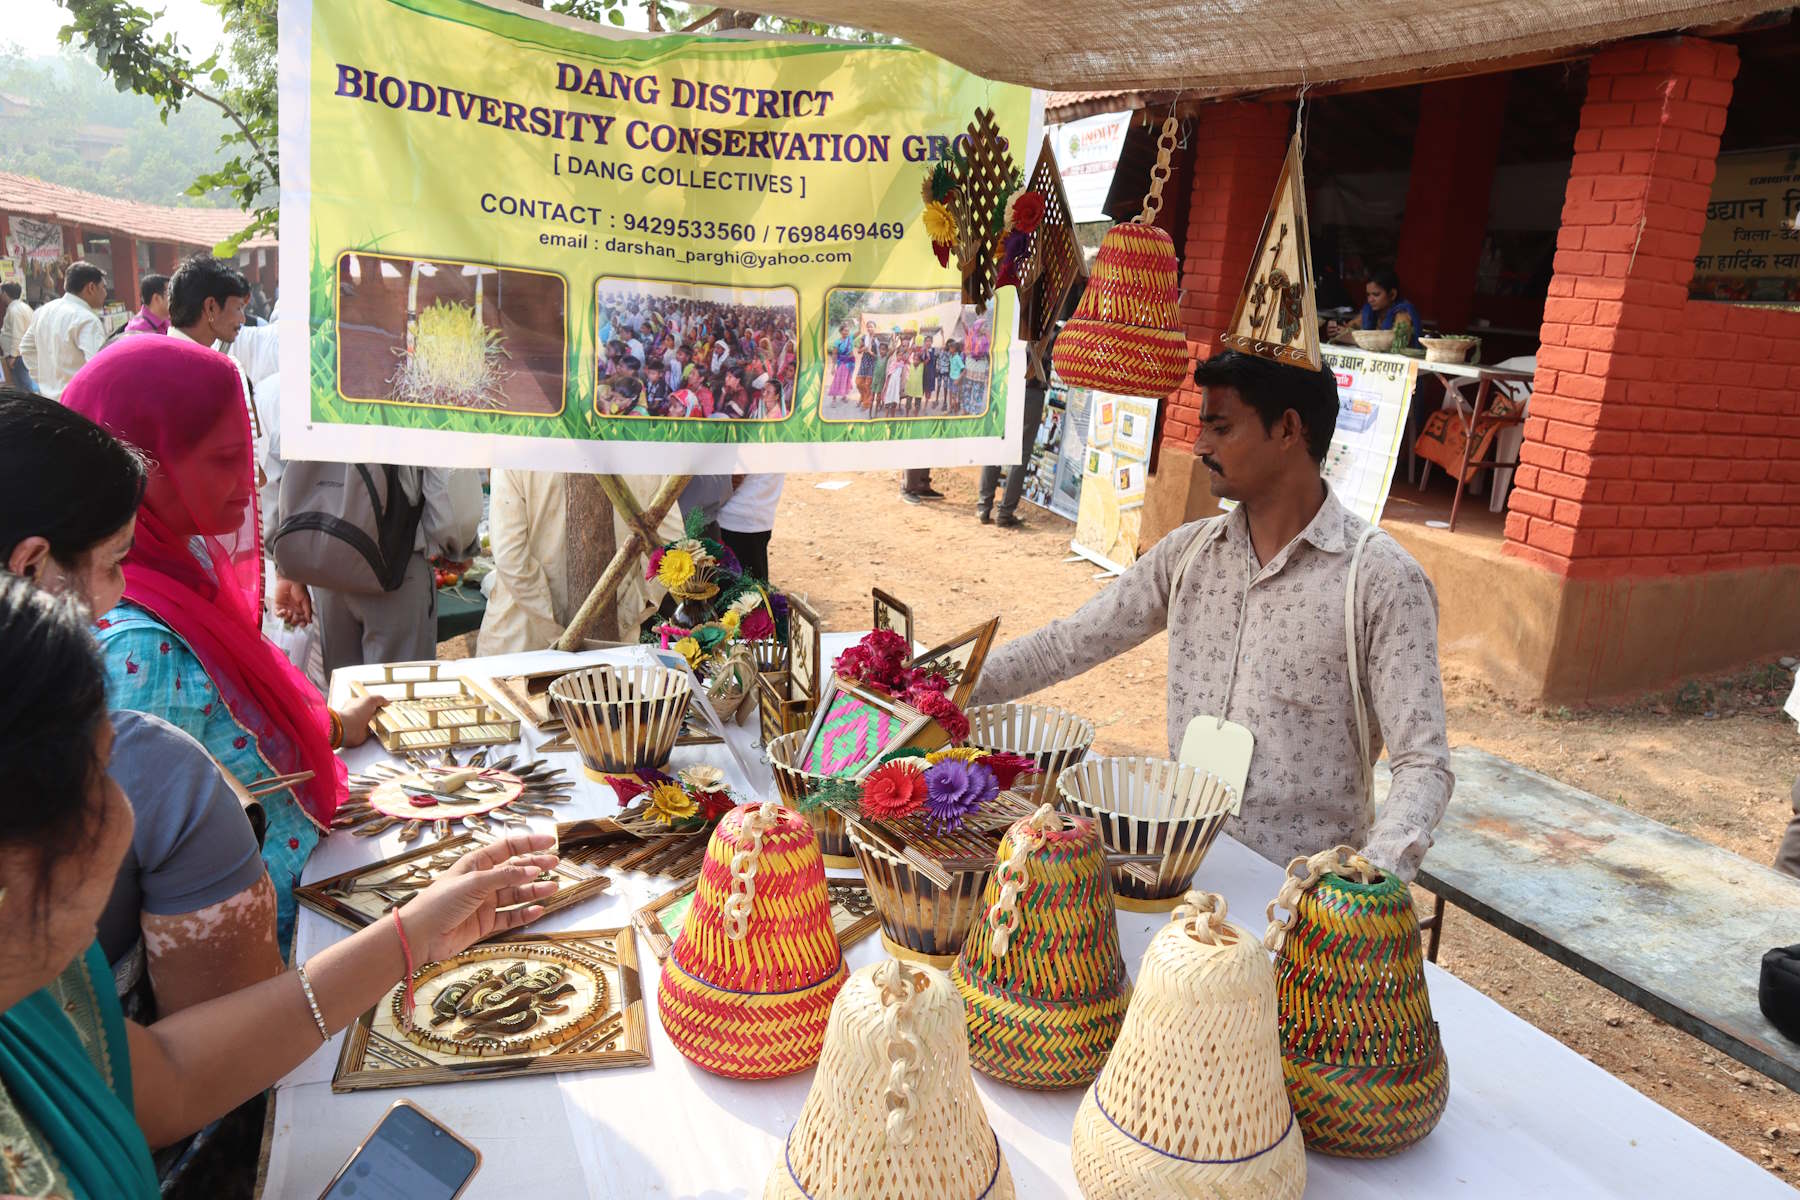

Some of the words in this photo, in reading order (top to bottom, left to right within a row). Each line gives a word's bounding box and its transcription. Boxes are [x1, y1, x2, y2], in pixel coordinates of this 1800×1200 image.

[556, 62, 660, 105] DANG
[671, 77, 833, 120] DISTRICT
[335, 63, 616, 146] BIODIVERSITY
[626, 120, 890, 163] CONSERVATION
[902, 134, 1009, 163] GRO
[568, 156, 633, 182] DANG
[642, 165, 793, 194] COLLECTIVES
[480, 193, 602, 226] CONTACT
[624, 213, 756, 242] 9429533560
[776, 222, 904, 244] 7698469469
[1706, 198, 1768, 220] उद्यान
[539, 233, 588, 249] email
[605, 237, 852, 269] darshan_parghi@yahoo.com
[1733, 226, 1771, 242] जिला
[1693, 254, 1713, 271] का
[1717, 248, 1768, 272] हार्दिक
